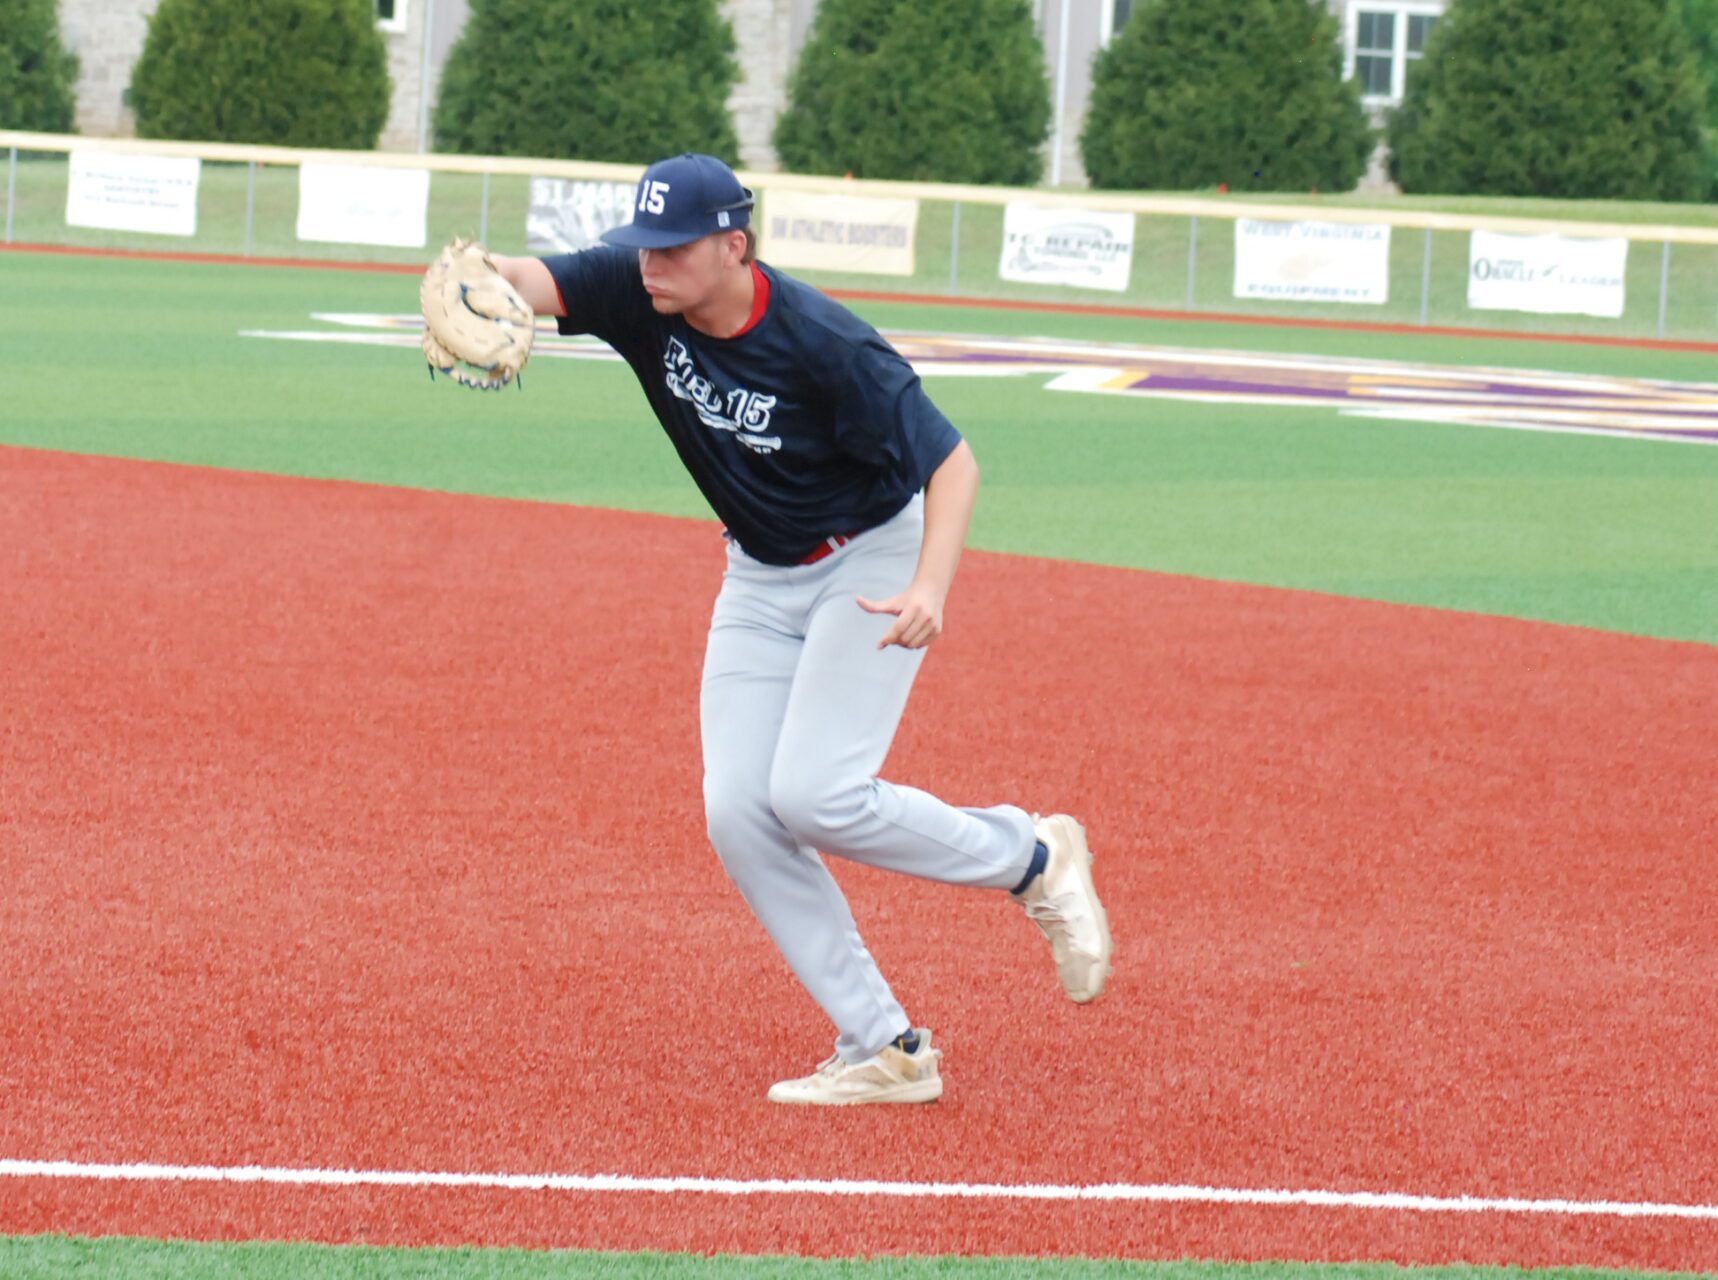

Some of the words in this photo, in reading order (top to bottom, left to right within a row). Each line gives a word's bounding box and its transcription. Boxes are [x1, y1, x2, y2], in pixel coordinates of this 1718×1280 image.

[638, 179, 670, 215] 15
[1242, 222, 1290, 238] WEST
[1299, 225, 1384, 241] VIRGINIA
[1045, 235, 1131, 254] REPAIR
[1247, 282, 1371, 298] EQUIPMENT
[726, 387, 778, 433] 15
